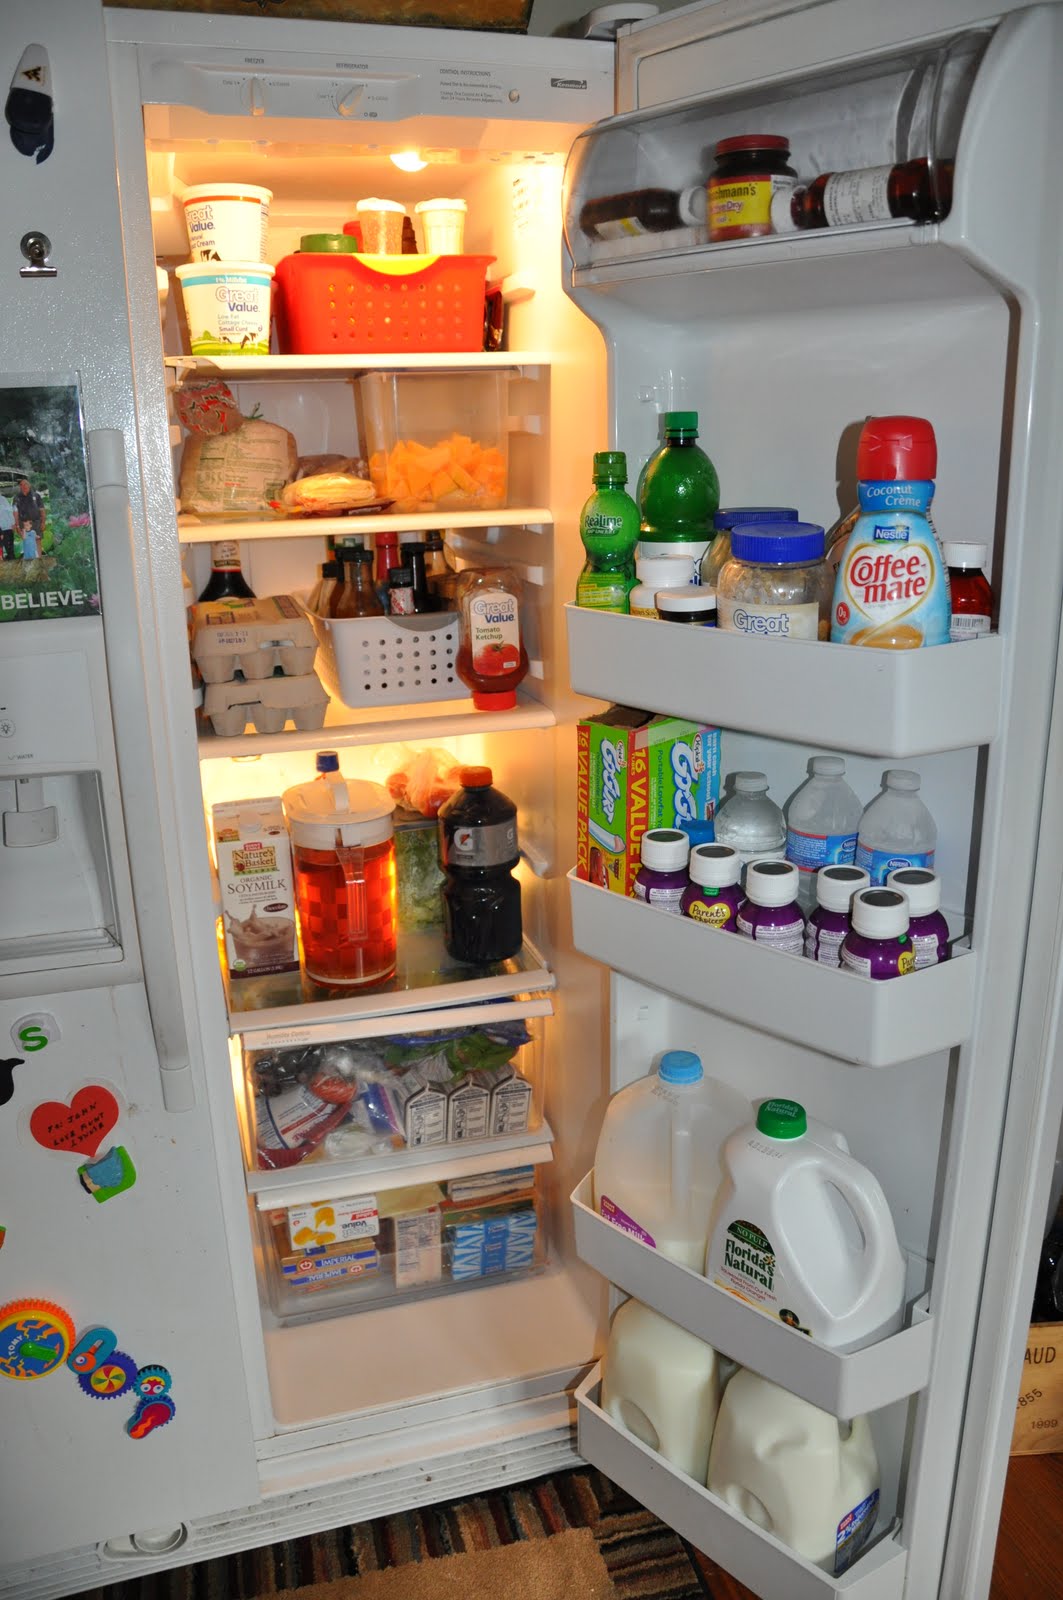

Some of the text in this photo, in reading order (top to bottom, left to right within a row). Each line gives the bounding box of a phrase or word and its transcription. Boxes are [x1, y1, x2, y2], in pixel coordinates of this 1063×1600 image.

[186, 205, 213, 222] reat
[228, 302, 258, 312] Value
[867, 485, 912, 498] Coconut
[864, 577, 925, 603] mate
[1, 590, 84, 610] BELIEVE
[474, 599, 514, 615] Great
[485, 613, 514, 623] Value
[733, 608, 789, 632] Great
[475, 633, 503, 641] Ketchup
[635, 749, 646, 773] 16
[577, 731, 588, 873] 16 VALUE PACK
[630, 777, 646, 855] VALUE
[234, 849, 274, 860] Nature's
[245, 859, 274, 867] Basket
[227, 879, 286, 894] SOYMILK
[240, 874, 272, 883] ORGANIC
[692, 904, 726, 918] Parent's
[18, 1026, 48, 1052] S
[736, 1227, 768, 1248] NO PULP
[321, 1254, 356, 1267] IMPERIAL
[725, 1238, 775, 1277] Florida's
[724, 1252, 773, 1291] Natural
[8, 1335, 23, 1356] TOMY
